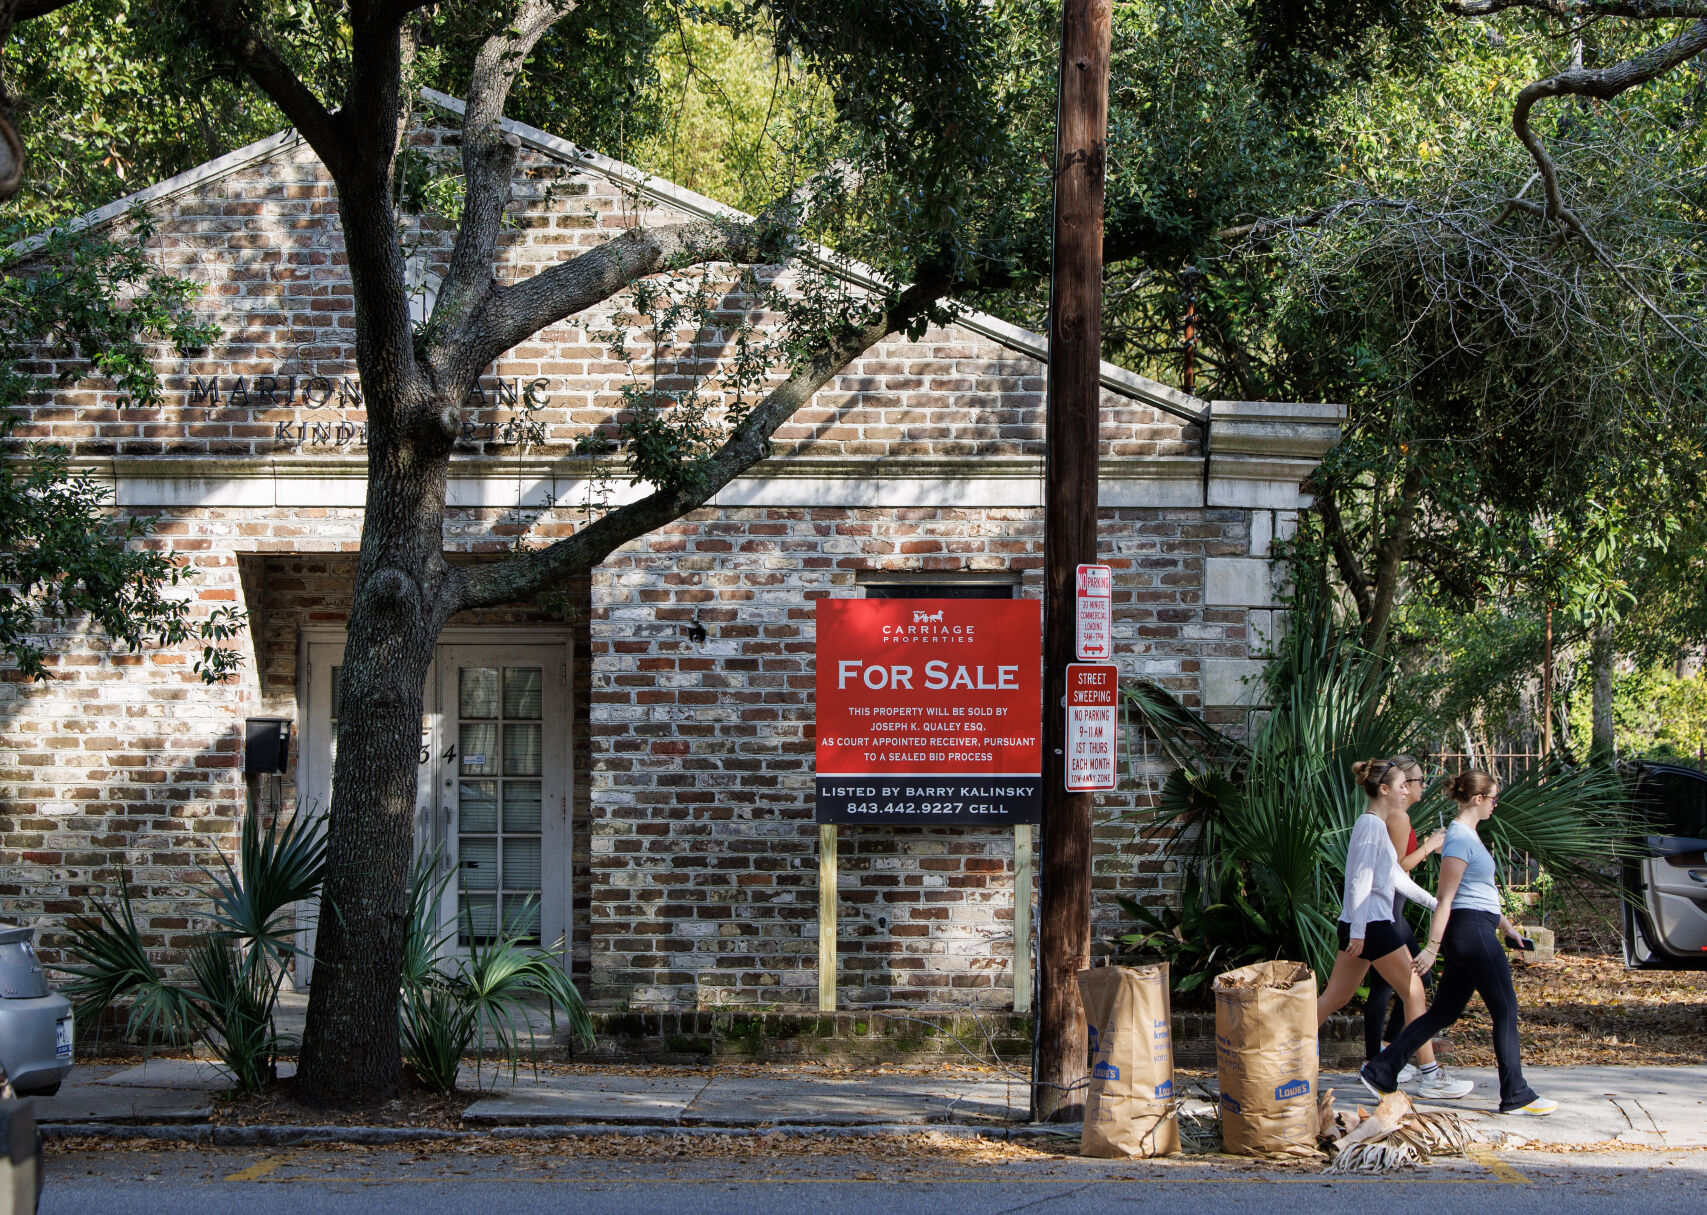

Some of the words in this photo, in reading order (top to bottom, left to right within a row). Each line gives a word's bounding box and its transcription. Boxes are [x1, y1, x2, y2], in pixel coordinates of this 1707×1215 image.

[192, 375, 364, 404] MARION
[1078, 573, 1087, 591] NO
[1087, 577, 1109, 589] PARKING
[1089, 600, 1105, 610] MINUTE
[1080, 611, 1107, 620] COMMERCIAL
[882, 625, 975, 634] CARRIAGE
[1084, 622, 1103, 631] LOADING
[837, 659, 915, 690] FOR
[924, 659, 1019, 691] SALE
[1077, 672, 1107, 685] STREET
[1073, 690, 1111, 703] SWEEPING
[849, 707, 871, 716] THIS
[873, 707, 924, 716] PROPERTY
[926, 707, 950, 716] WILL
[952, 707, 965, 716] BE
[967, 707, 993, 716] SOLD
[995, 707, 1008, 716] BY
[1074, 709, 1083, 721] NO
[1084, 709, 1110, 721] PARKING
[870, 722, 908, 731] JOSEPH
[910, 722, 920, 731] K.
[923, 722, 961, 732] QUALEY
[964, 722, 986, 732] ESQ.
[821, 737, 834, 746] AS
[836, 737, 870, 746] COURT
[872, 737, 927, 746] APPOINTED
[930, 737, 981, 747] RECEIVER,
[983, 737, 1036, 746] PURSUANT
[1075, 742, 1086, 754] 1ST
[1088, 742, 1108, 754] THURS
[863, 752, 877, 761] TO
[879, 752, 886, 761] A
[888, 752, 926, 761] SEALED
[929, 752, 945, 761] BID
[948, 752, 993, 761] PROCESS
[1072, 758, 1088, 771] EACH
[1089, 758, 1110, 770] MONTH
[1071, 774, 1096, 784] TOW-AWAY
[1097, 774, 1111, 783] ZONE
[822, 787, 876, 797] LISTED
[882, 787, 900, 797] BY
[905, 787, 955, 797] BARRY
[960, 787, 1035, 797] KALINSKY
[846, 802, 964, 814] 843.442.9227
[969, 805, 1008, 814] CELL
